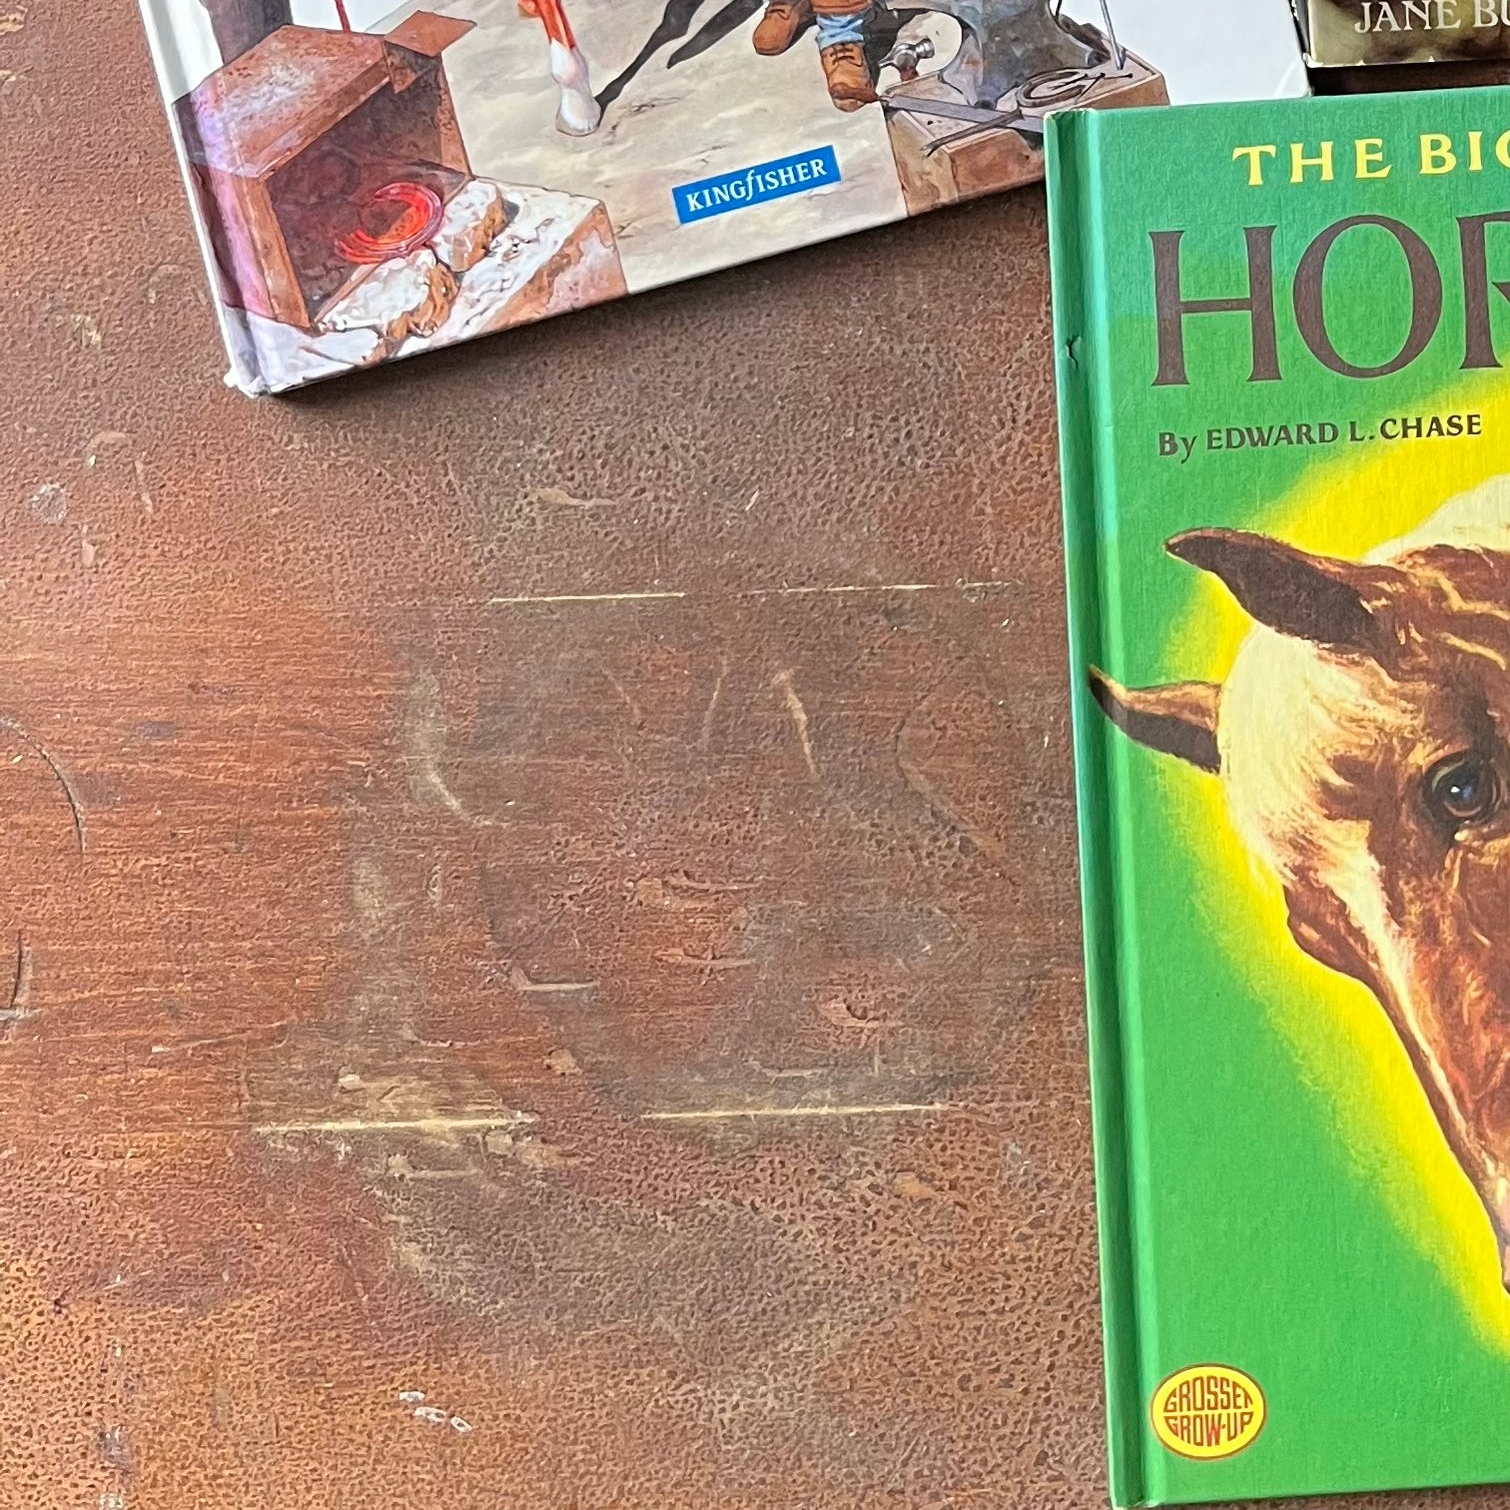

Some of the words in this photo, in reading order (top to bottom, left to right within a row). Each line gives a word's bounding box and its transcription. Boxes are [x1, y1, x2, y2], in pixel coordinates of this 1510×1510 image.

[1232, 137, 1392, 186] THE
[1157, 429, 1199, 462] By
[1206, 421, 1339, 451] EDWARD
[1163, 1411, 1254, 1447] GROW-UP
